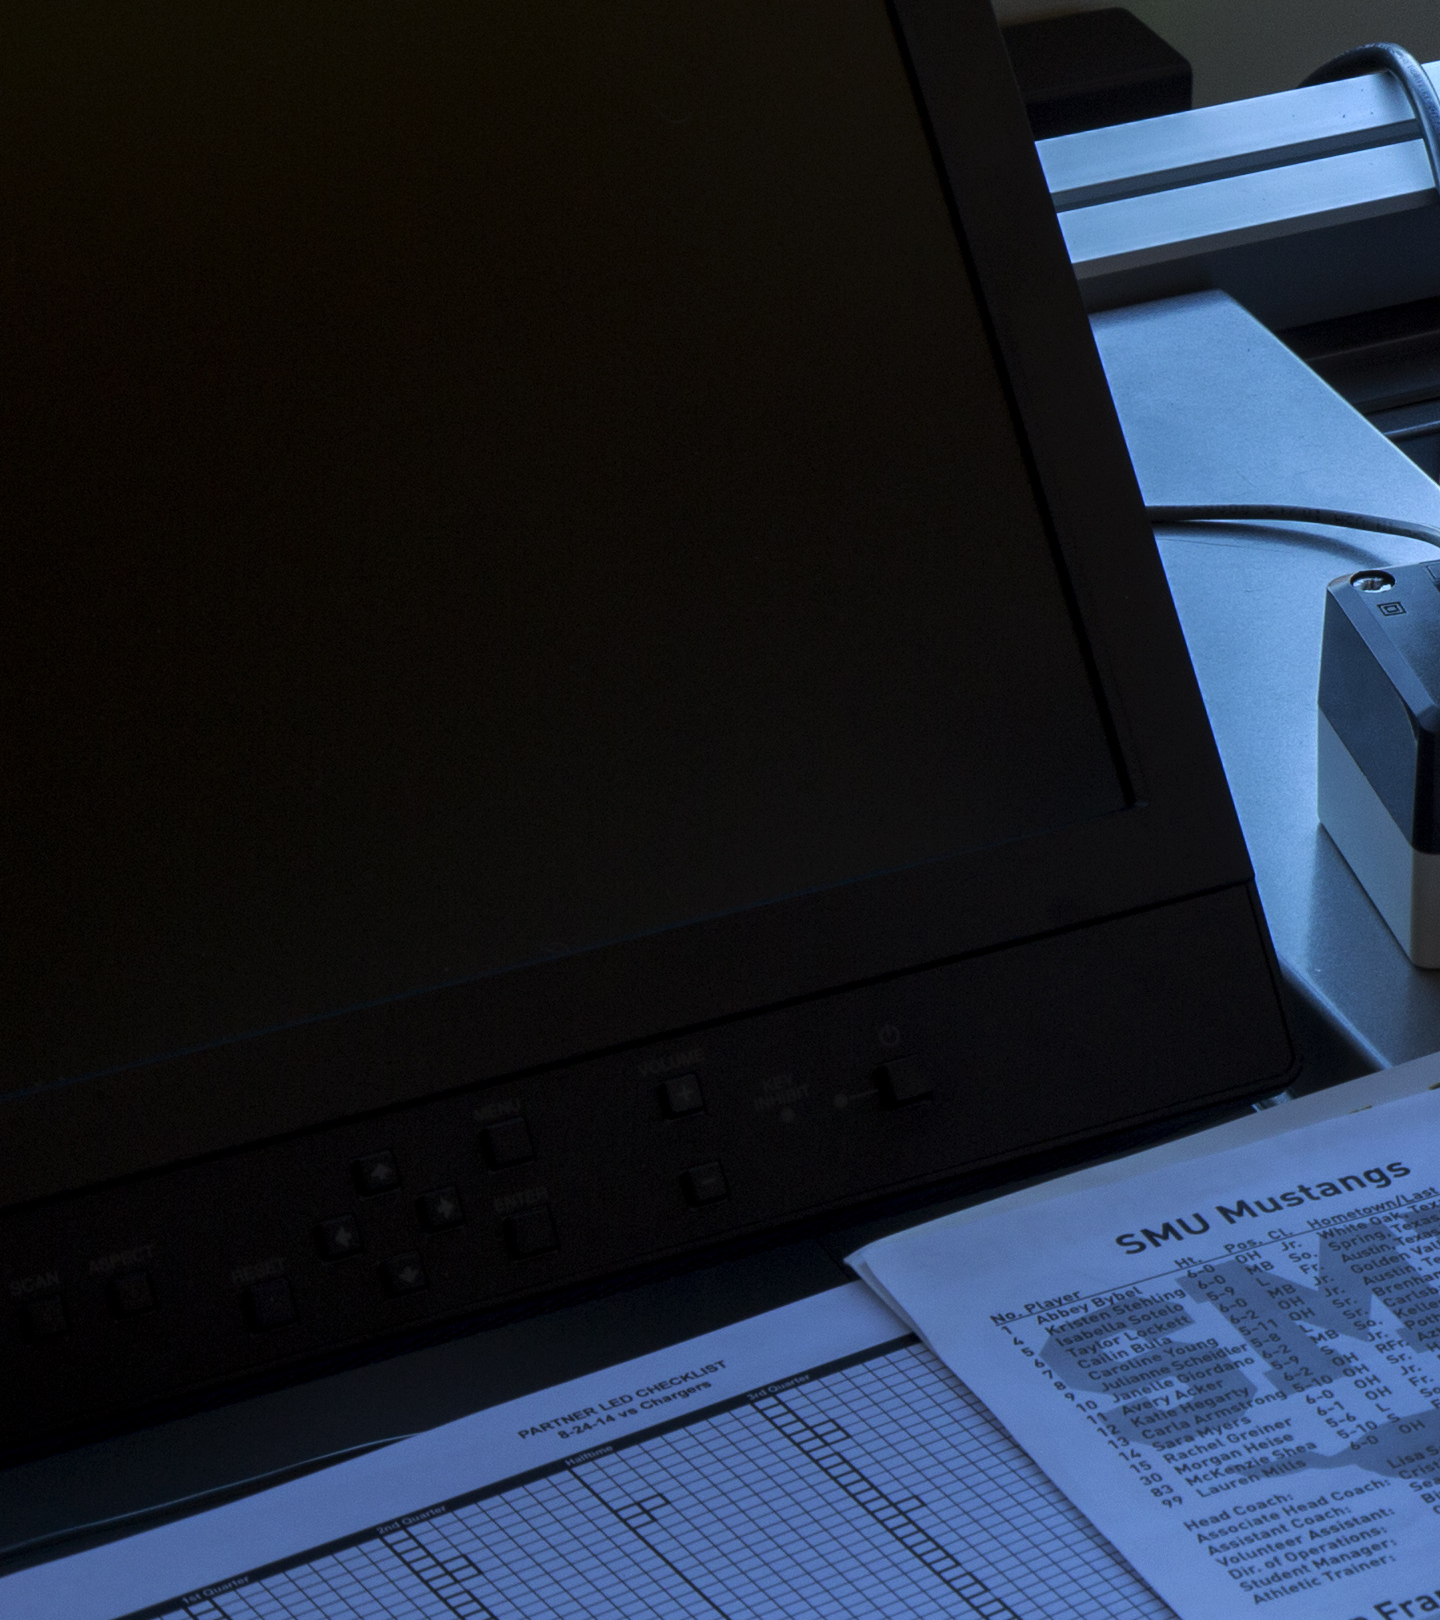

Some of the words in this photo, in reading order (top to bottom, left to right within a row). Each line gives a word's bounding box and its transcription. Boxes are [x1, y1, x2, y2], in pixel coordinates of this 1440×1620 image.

[1115, 1213, 1211, 1256] SMU
[1216, 1158, 1413, 1229] Mustangs
[1024, 1289, 1081, 1314] Player
[1307, 1185, 1437, 1230] Hometown/Last
[1037, 1302, 1090, 1325] Abbey
[1092, 1287, 1143, 1313] Bybel
[1046, 1313, 1110, 1336] Kristen
[1112, 1287, 1187, 1315] Stehling
[516, 1400, 597, 1440] PARTNER
[598, 1390, 634, 1413] LED
[636, 1359, 728, 1401] CHECKLIST
[641, 1381, 712, 1411] Chargers
